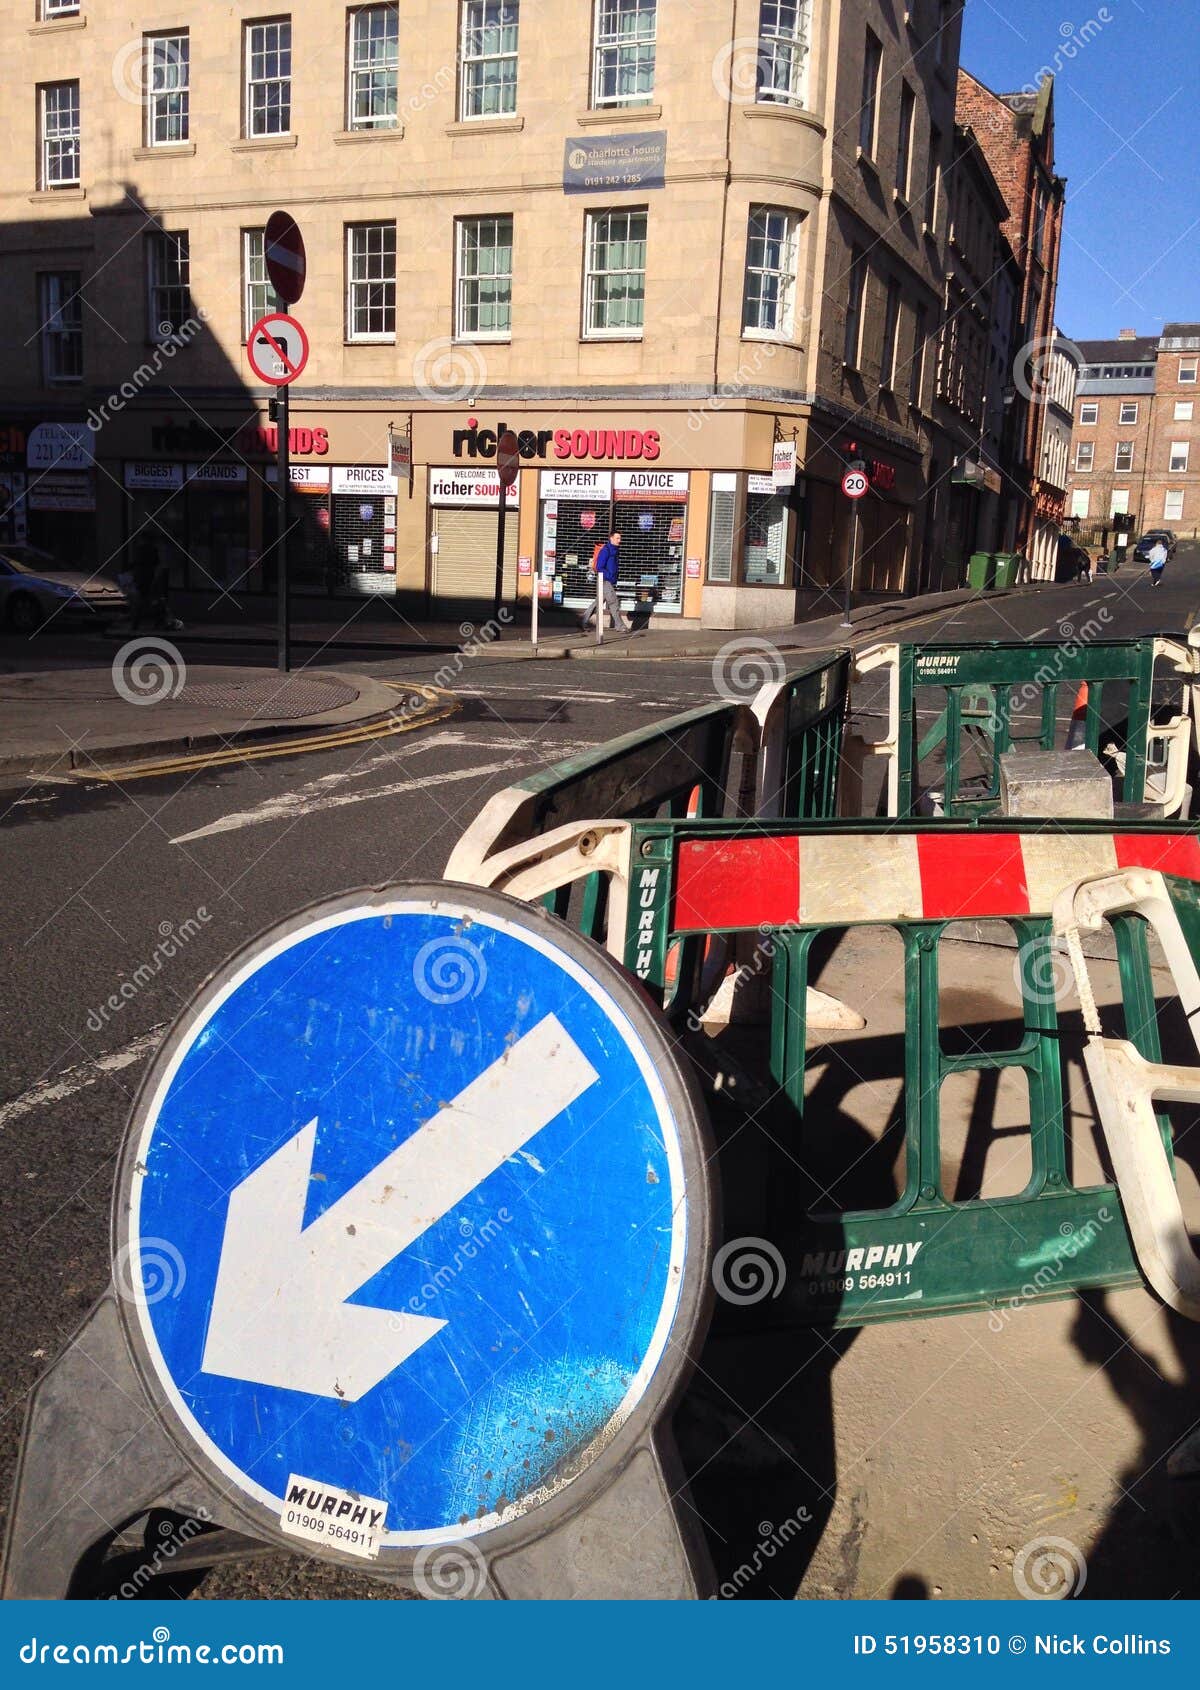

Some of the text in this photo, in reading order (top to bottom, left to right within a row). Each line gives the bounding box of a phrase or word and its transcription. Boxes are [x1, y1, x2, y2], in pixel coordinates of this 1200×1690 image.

[588, 148, 631, 159] charlotte
[632, 145, 660, 155] house
[584, 174, 641, 186] 0191 242 1285
[554, 429, 661, 460] SOUNDS
[774, 450, 793, 461] richer
[134, 464, 174, 477] BIGGEST
[196, 465, 238, 479] BRANDS
[346, 469, 384, 482] PRICES
[454, 470, 496, 479] WELCOME TO
[554, 473, 674, 487] EXPERT ADVICE
[433, 479, 474, 496] richer
[846, 478, 865, 490] 20
[916, 656, 961, 667] MURPHY
[800, 1241, 923, 1277] MURPHY
[808, 1271, 911, 1295] 01909 564911
[287, 1485, 383, 1528] MURPHY
[287, 1510, 374, 1548] 01909 564911
